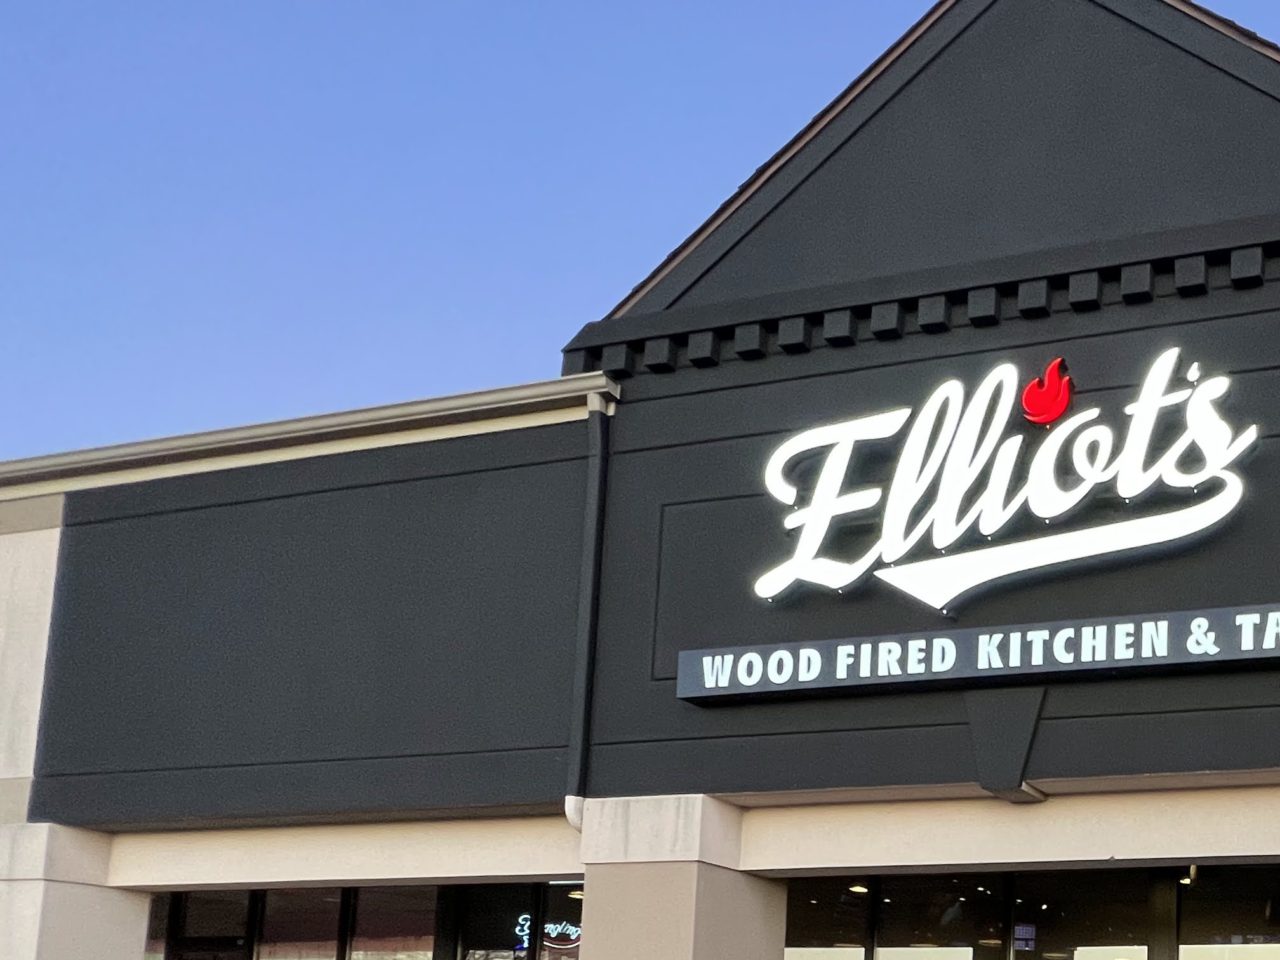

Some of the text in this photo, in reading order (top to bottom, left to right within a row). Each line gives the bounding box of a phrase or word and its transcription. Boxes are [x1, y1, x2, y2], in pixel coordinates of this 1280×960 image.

[754, 346, 1258, 610] Elliot's
[702, 648, 822, 689] WOOD
[835, 638, 957, 680] FIRED
[977, 620, 1169, 669] KITCHEN
[1186, 617, 1221, 656] &
